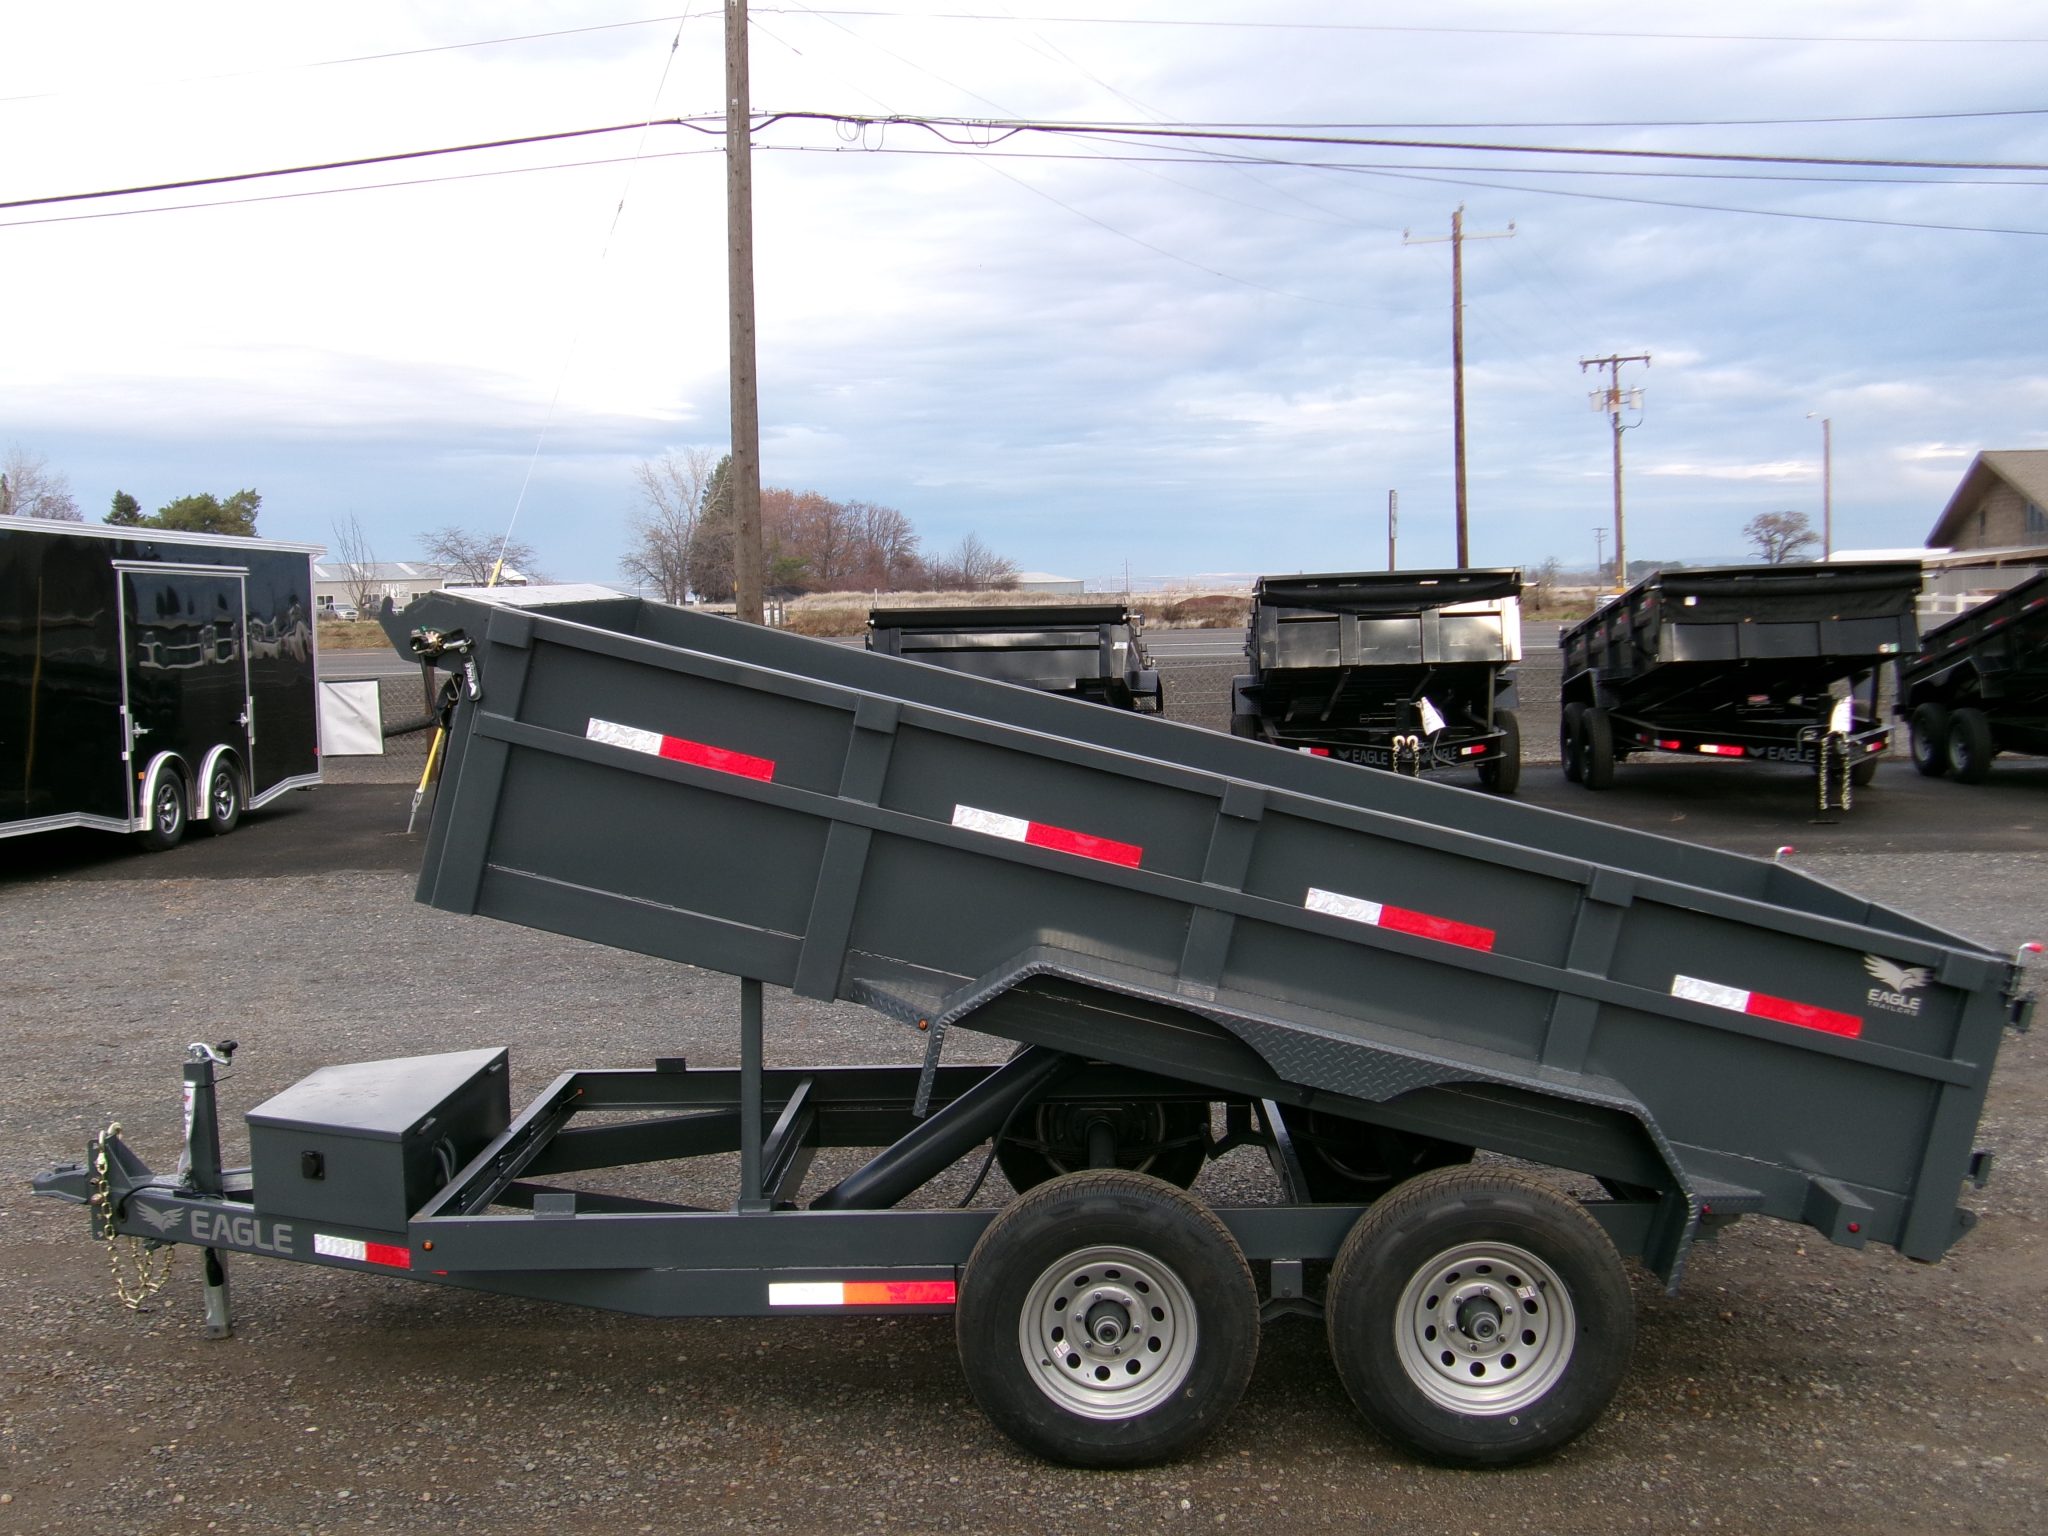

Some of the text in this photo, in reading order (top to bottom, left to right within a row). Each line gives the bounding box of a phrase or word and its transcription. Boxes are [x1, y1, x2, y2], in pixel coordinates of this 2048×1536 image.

[1353, 749, 1388, 766] EAGLE
[1866, 1000, 1919, 1016] TRAILERS
[1867, 988, 1921, 1010] EAGLE
[190, 1210, 293, 1254] EAGLE
